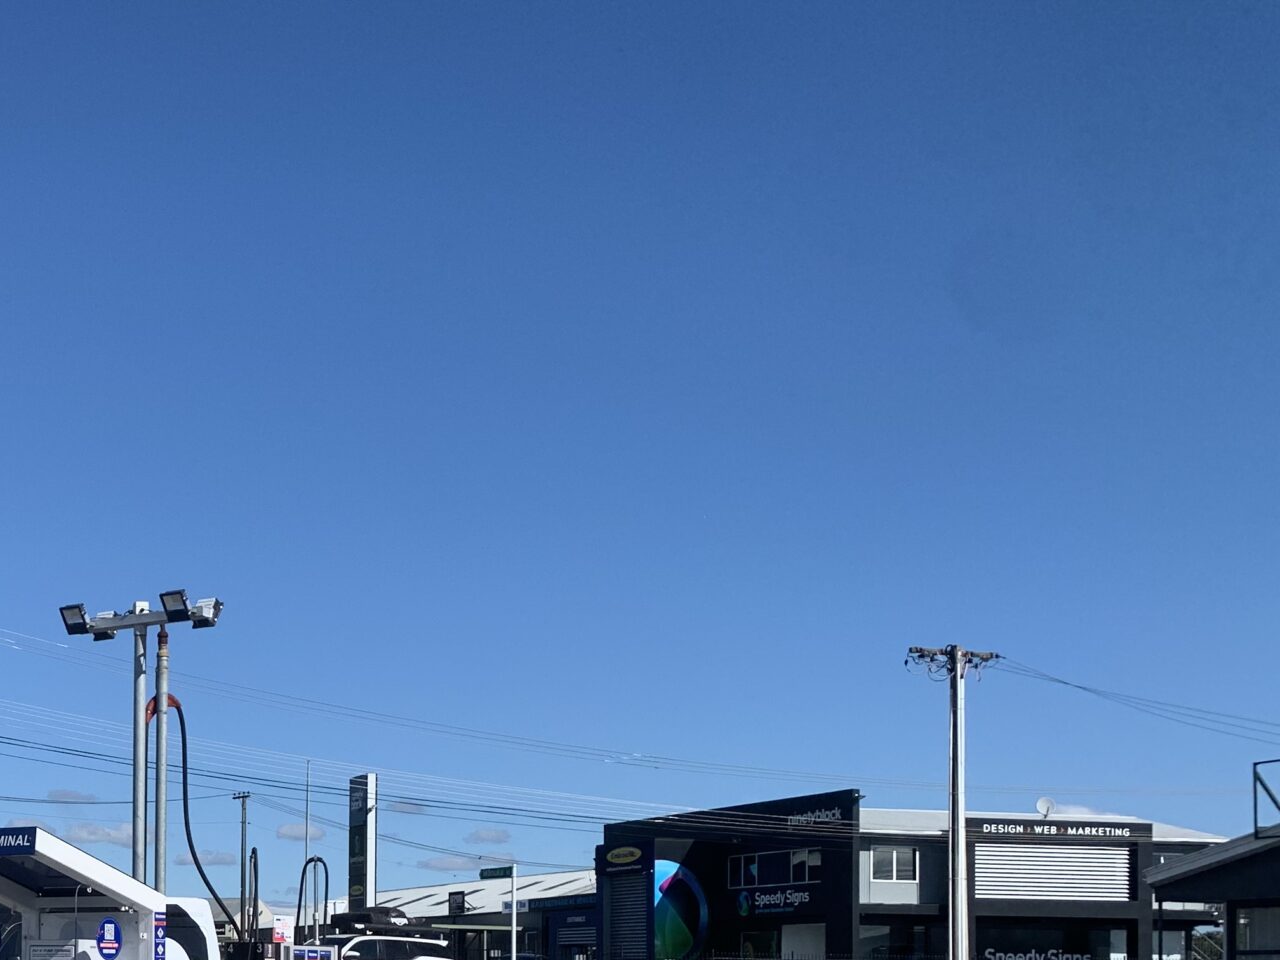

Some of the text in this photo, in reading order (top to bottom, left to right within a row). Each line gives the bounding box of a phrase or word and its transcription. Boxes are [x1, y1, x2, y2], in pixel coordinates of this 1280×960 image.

[983, 824, 1130, 837] DESIGN WEB MARKETING
[755, 889, 810, 907] Speedy Signs
[227, 943, 234, 953] 4
[256, 943, 263, 953] 3
